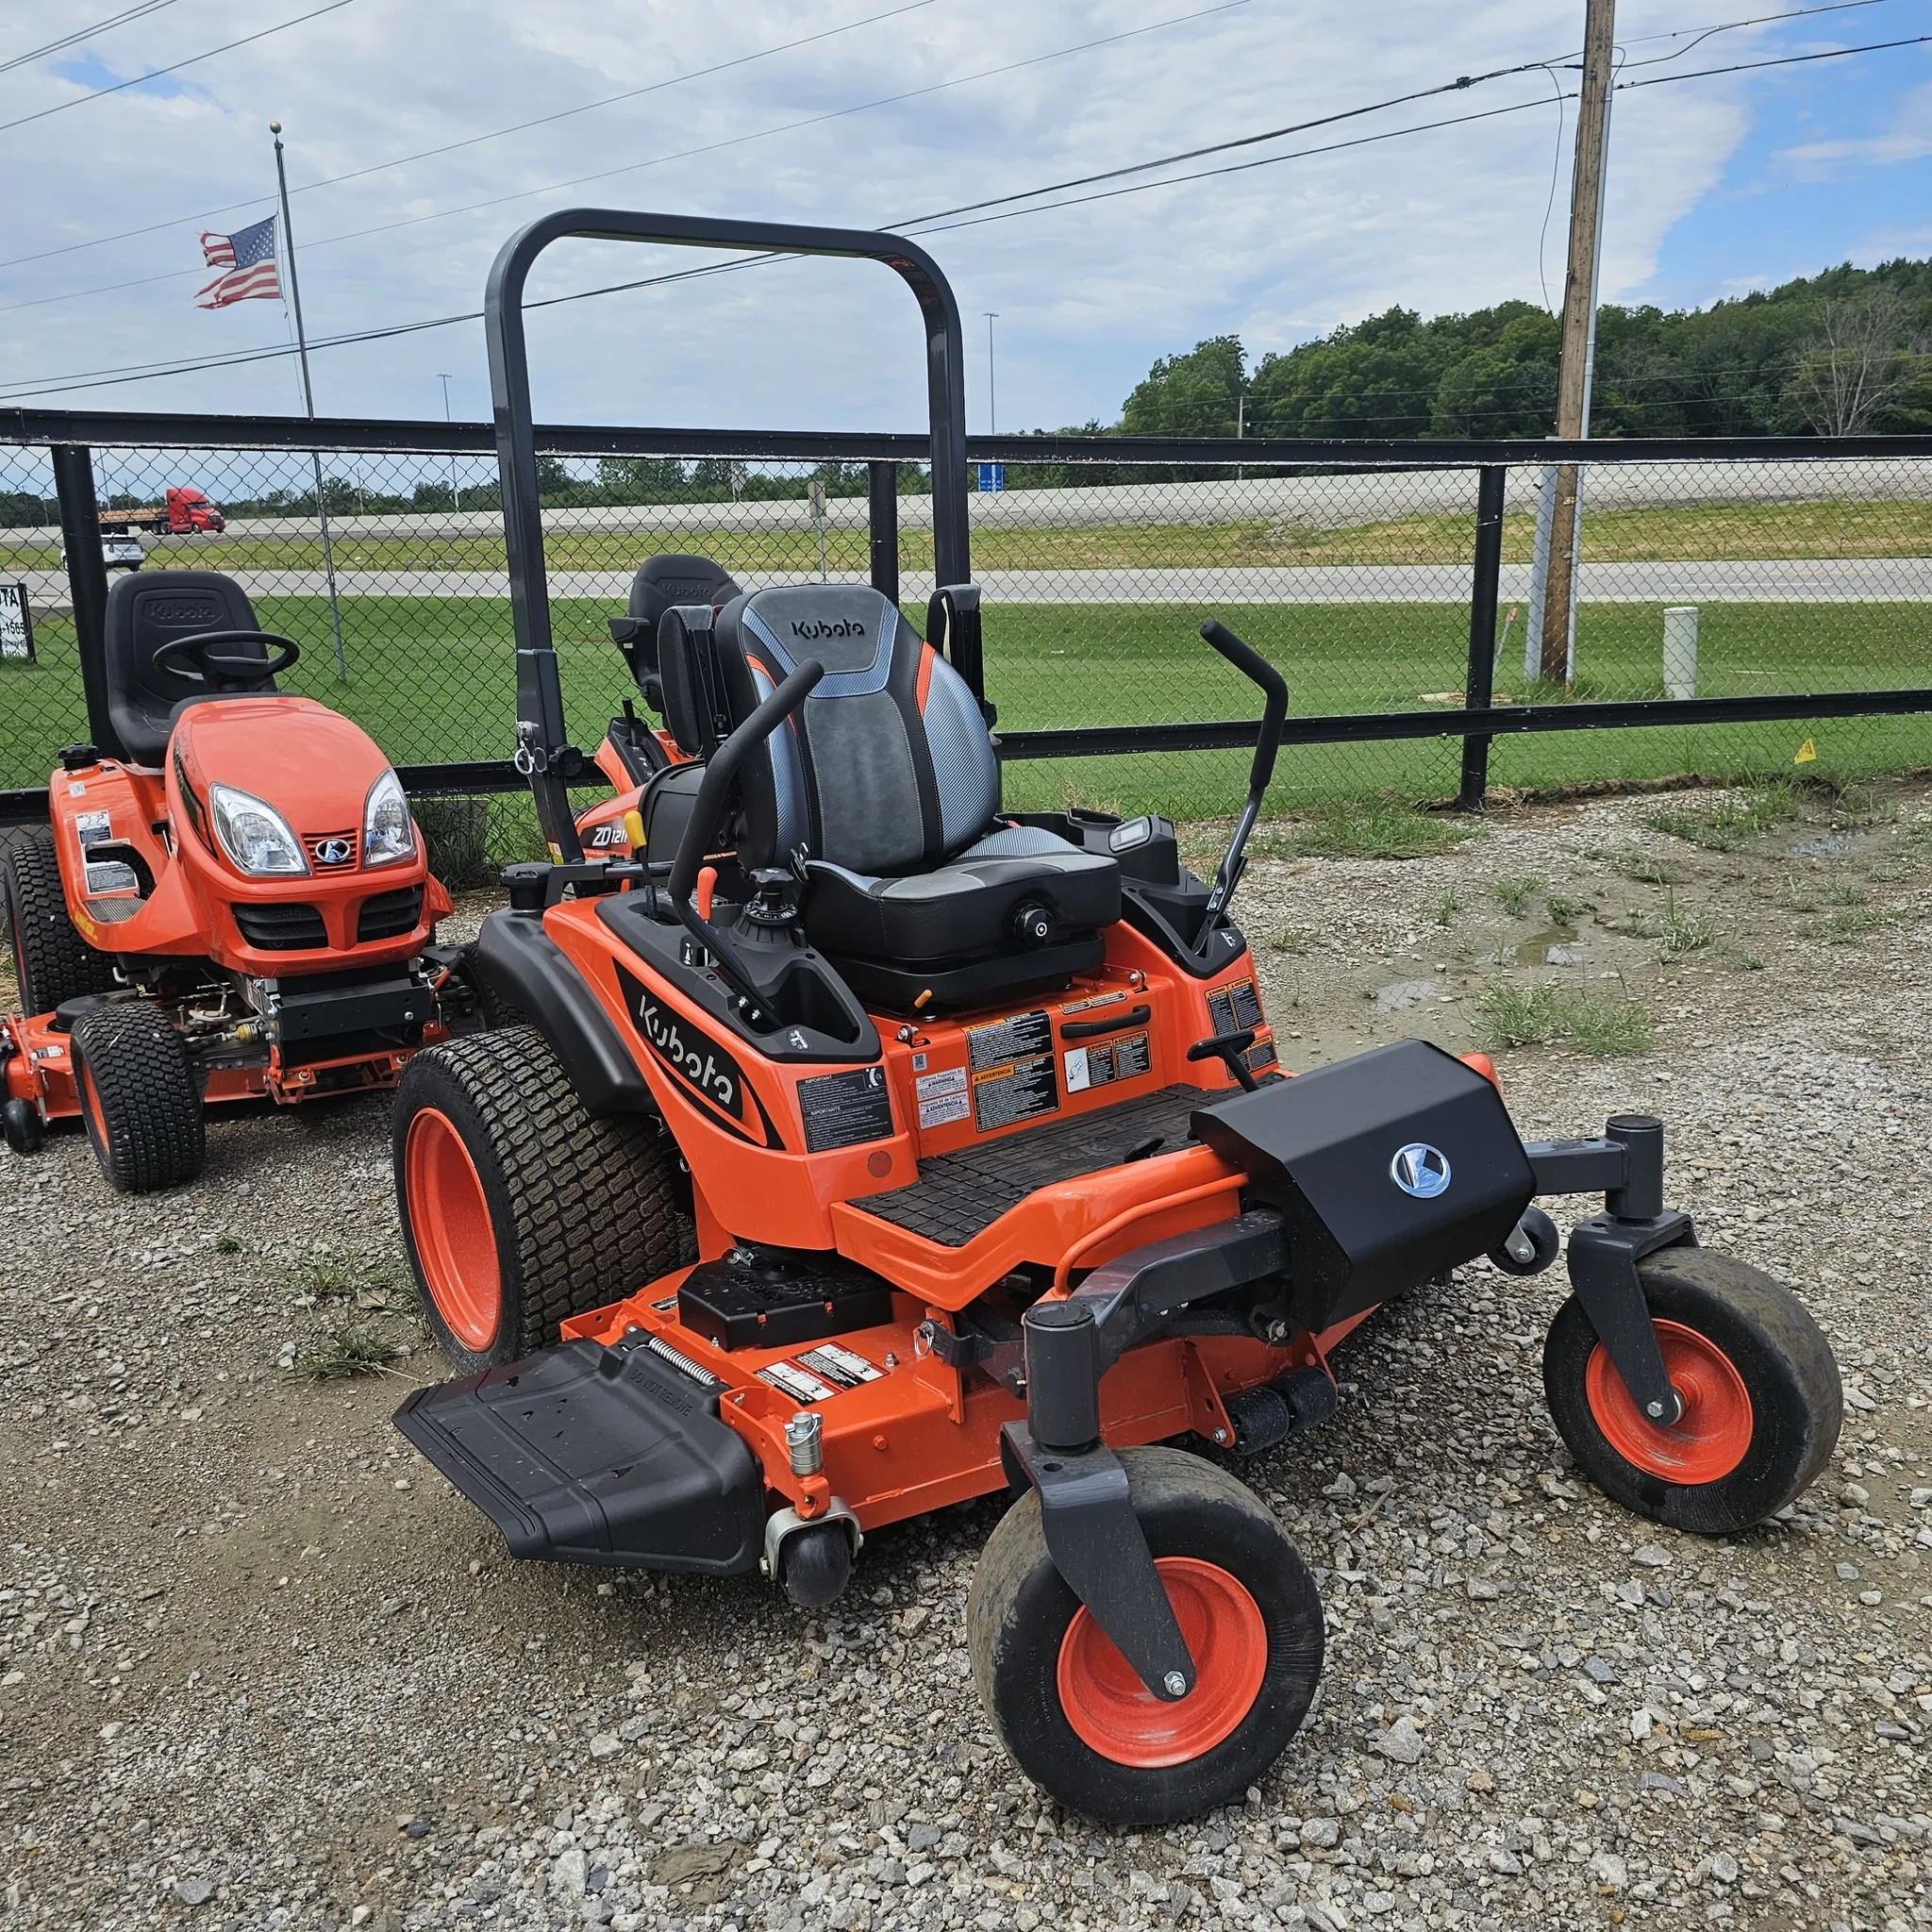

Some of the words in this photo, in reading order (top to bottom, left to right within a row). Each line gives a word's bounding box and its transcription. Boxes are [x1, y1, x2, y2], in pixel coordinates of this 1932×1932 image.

[662, 583, 712, 597] Kubota
[151, 603, 216, 619] Kubota
[0, 622, 26, 635] -1565
[791, 618, 865, 640] Kubota
[639, 994, 734, 1106] Kubota
[805, 1075, 833, 1084] IMPORTANT
[980, 1068, 1012, 1080] ADVERTENCIA
[811, 1106, 841, 1115] IMPORTANTE
[630, 1370, 643, 1384] DO
[643, 1378, 662, 1394] NOT
[658, 1389, 693, 1417] REMOVE
